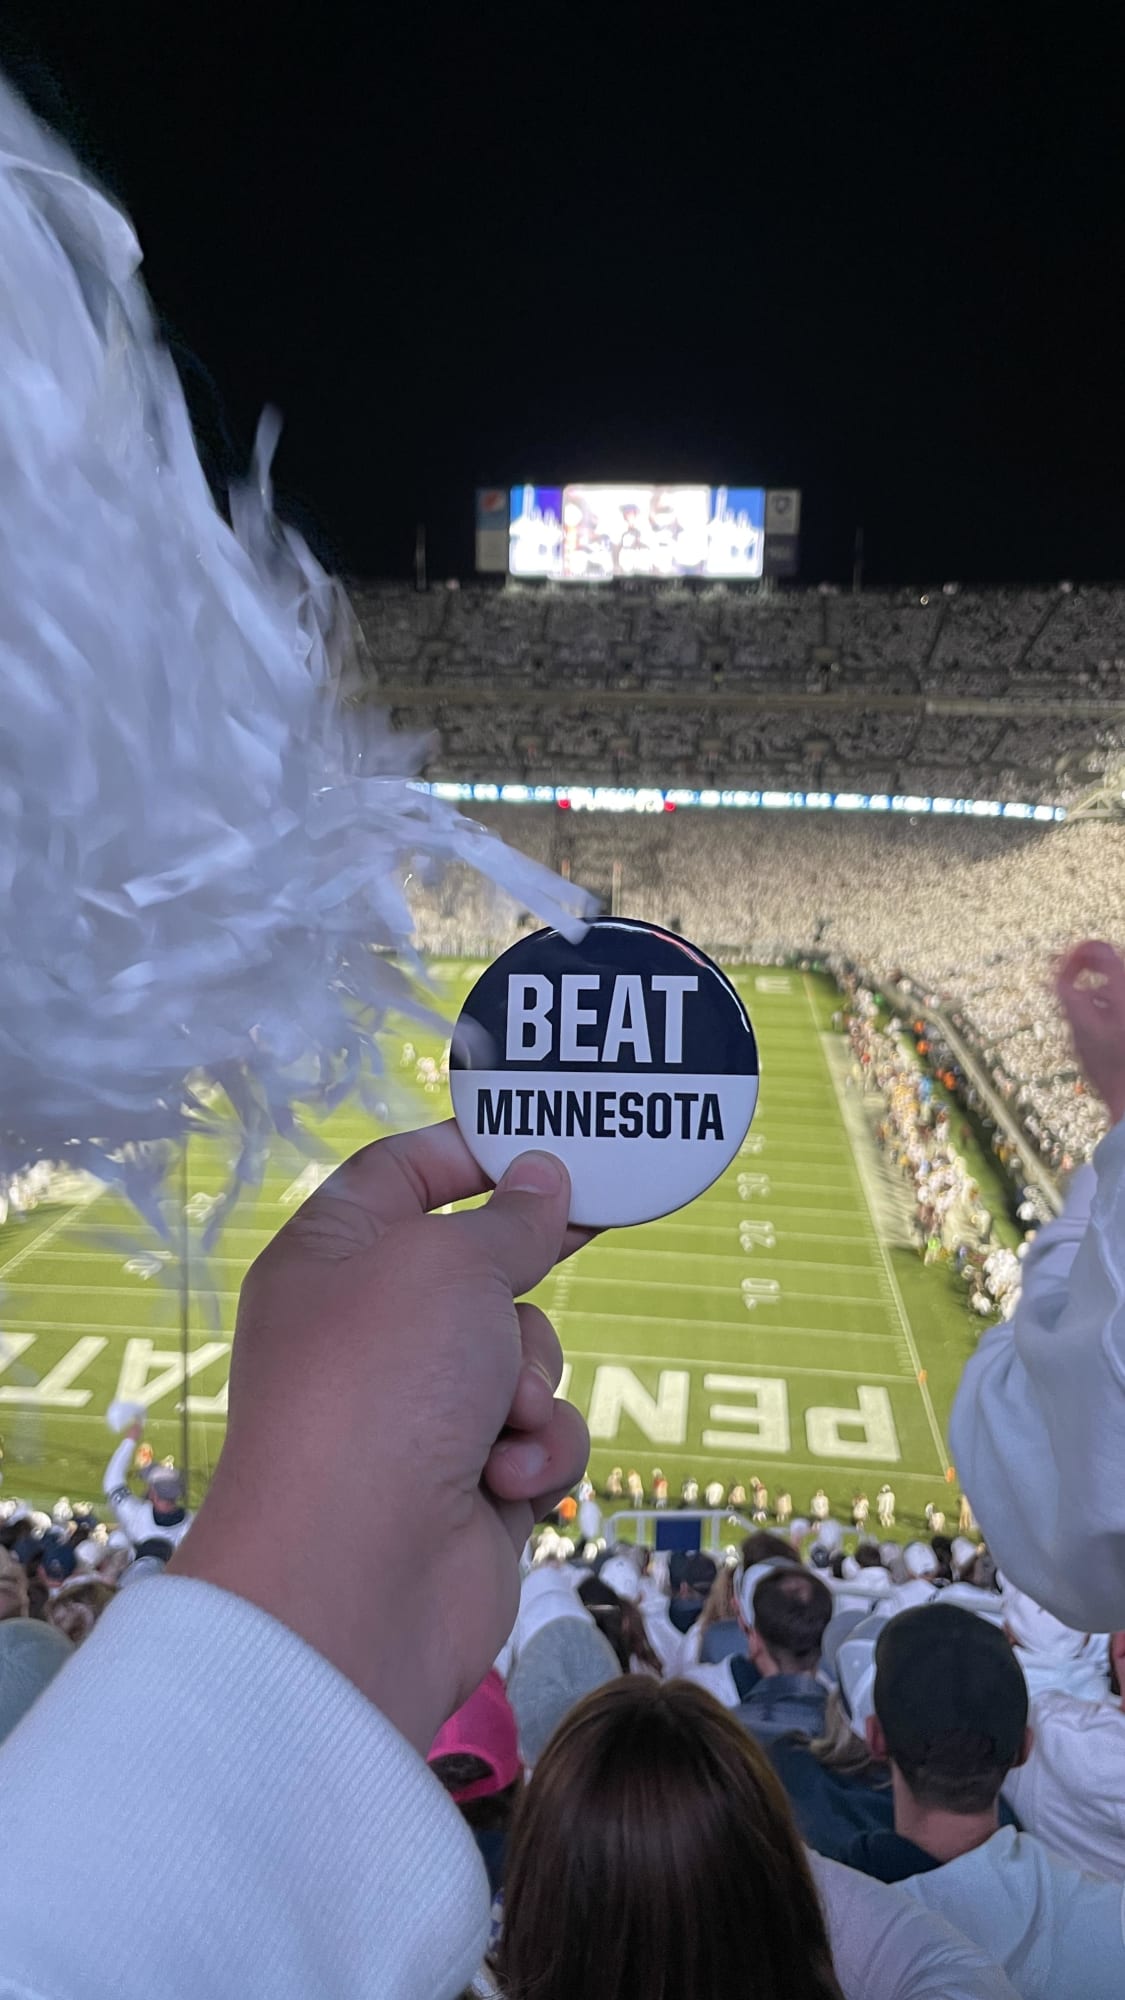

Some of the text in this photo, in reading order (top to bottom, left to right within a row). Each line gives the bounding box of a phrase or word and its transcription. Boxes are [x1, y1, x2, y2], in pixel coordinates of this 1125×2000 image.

[505, 973, 699, 1064] BEAT
[476, 1088, 725, 1141] MINNESOTA
[739, 1219, 776, 1252] 20
[741, 1277, 781, 1310] 10
[552, 1361, 901, 1462] PEN
